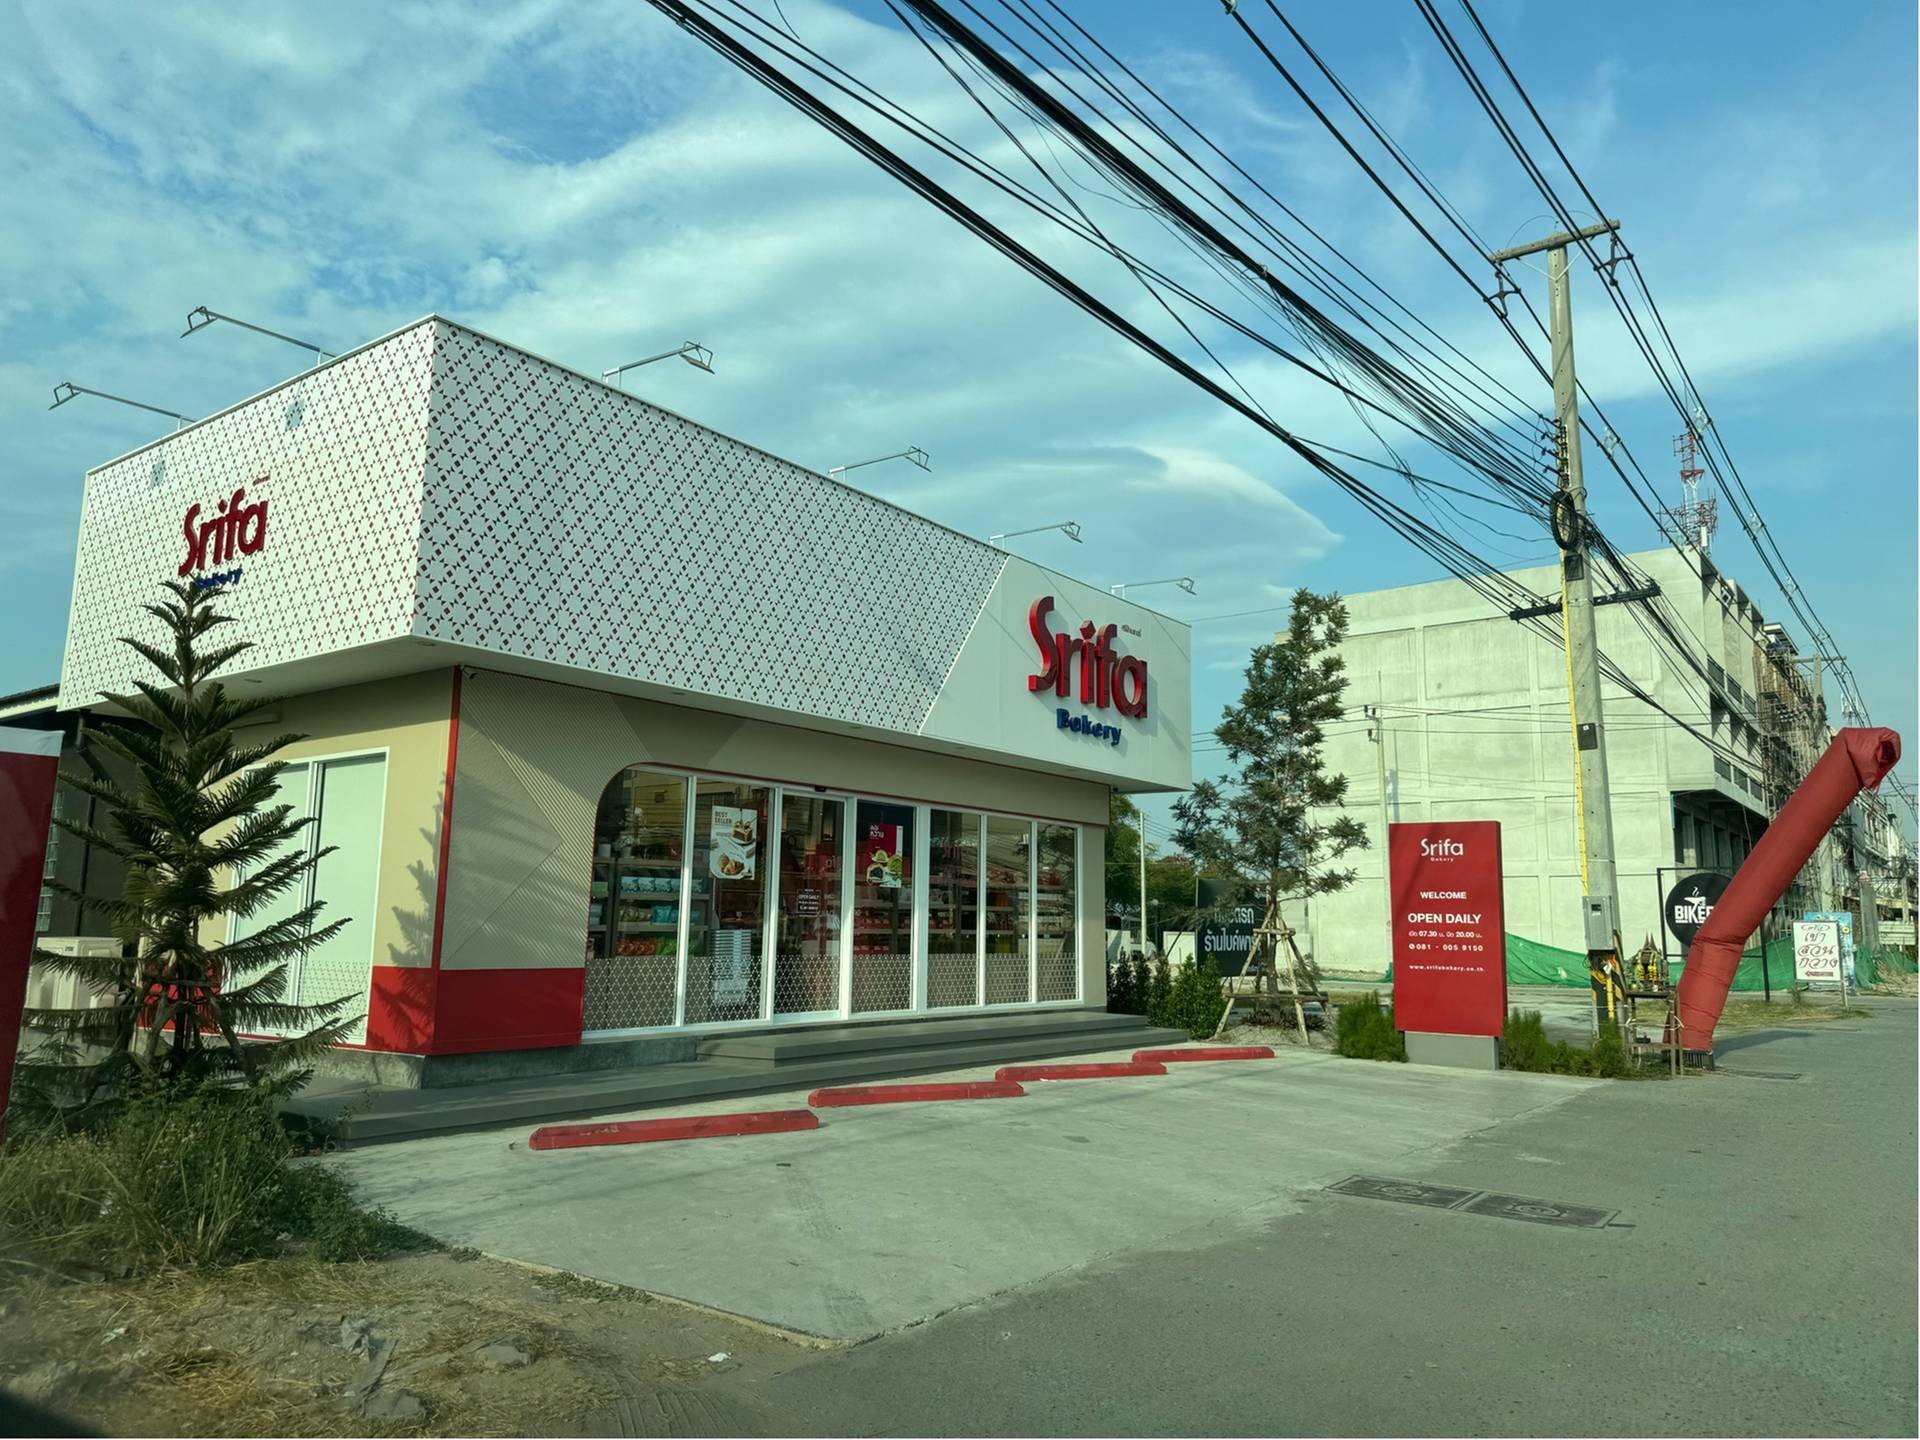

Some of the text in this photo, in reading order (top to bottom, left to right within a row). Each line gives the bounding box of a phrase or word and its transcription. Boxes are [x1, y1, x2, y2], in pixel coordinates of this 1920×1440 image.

[178, 488, 268, 577] Srifa
[1028, 595, 1148, 718] Srifa
[1056, 708, 1122, 746] Bakery
[1420, 838, 1464, 857] Srifa
[1420, 891, 1467, 900] WELCOME
[1407, 913, 1482, 925] OPEN DAILY
